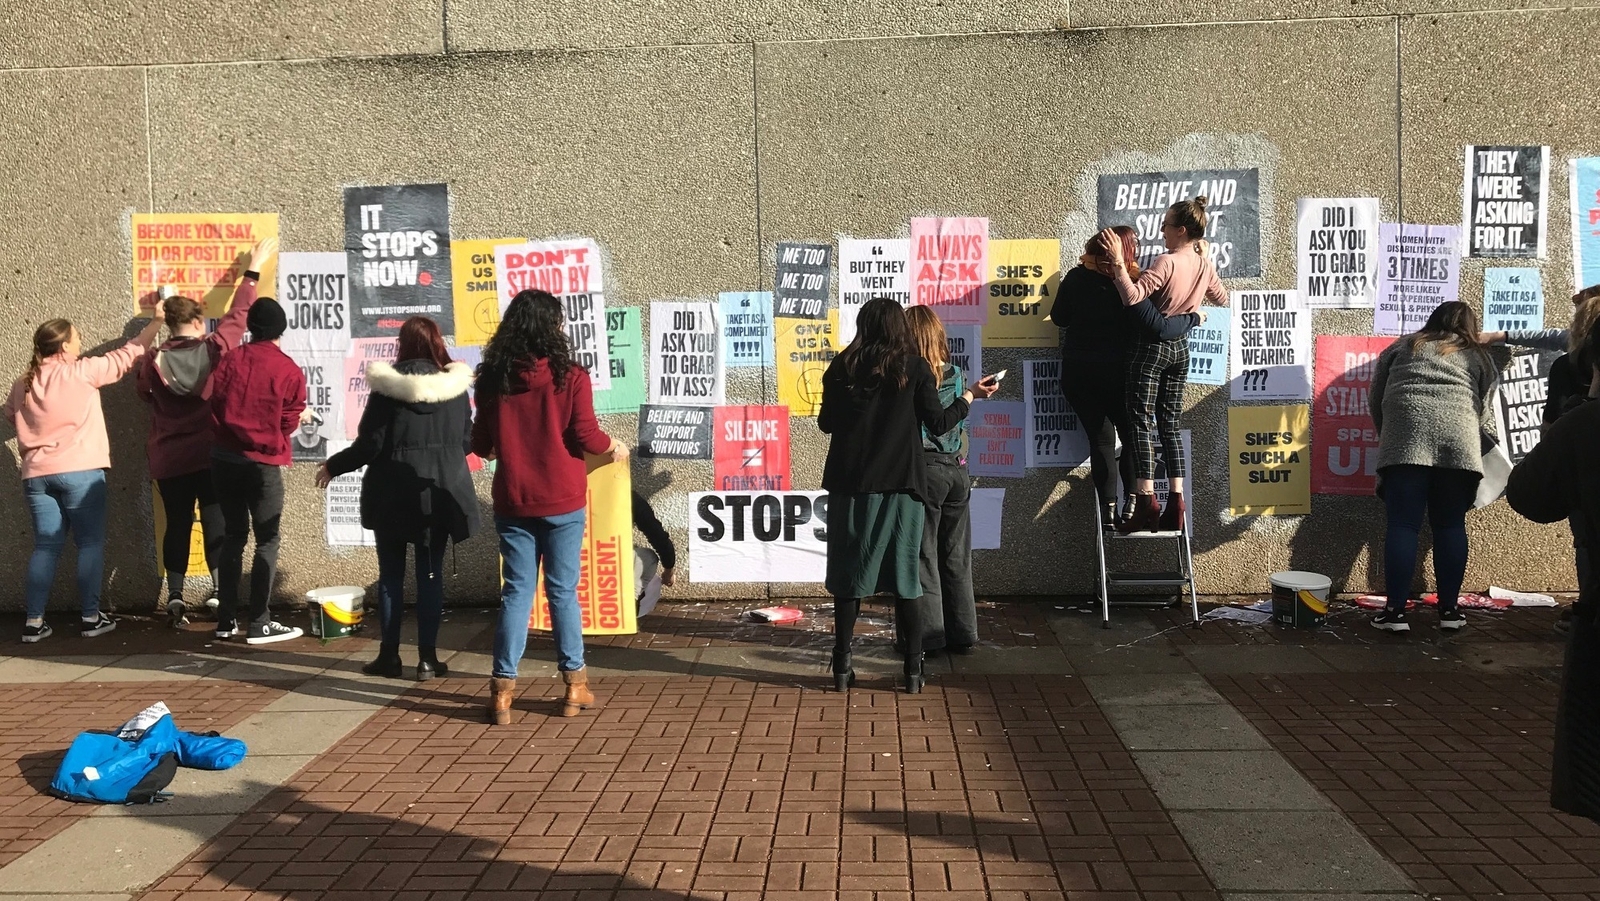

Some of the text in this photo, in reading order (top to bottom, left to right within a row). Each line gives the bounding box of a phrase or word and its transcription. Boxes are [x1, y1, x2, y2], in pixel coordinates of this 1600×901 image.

[1478, 151, 1518, 173] THEY
[1115, 181, 1192, 210] BELIEVE
[1477, 176, 1522, 199] WERE
[360, 204, 382, 230] IT
[1322, 207, 1353, 227] DID I
[1475, 201, 1534, 224] ASKING
[137, 224, 256, 241] BEFORE YOU SAY,
[1309, 230, 1366, 250] ASK YOU
[1395, 235, 1423, 244] WOMEN
[1474, 226, 1526, 249] FOR IT.
[362, 231, 438, 258] STOPS
[917, 235, 982, 261] ALWAYS
[1387, 245, 1436, 254] DISABILITIES
[138, 246, 159, 261] DO
[162, 246, 180, 261] OR
[184, 246, 220, 261] POST
[471, 254, 495, 264] GIV
[505, 248, 588, 269] DON'T
[782, 248, 825, 265] ME TOO
[850, 261, 905, 273] BUT THEY
[996, 265, 1043, 278] SHE'S
[1310, 253, 1366, 273] TO GRAB
[1388, 256, 1449, 280] 3 TIMES
[138, 268, 240, 283] CHECK IF THEY
[363, 260, 433, 287] NOW.
[472, 268, 492, 278] US
[917, 263, 979, 281] ASK
[287, 274, 345, 301] SEXIST
[507, 266, 590, 298] STAND BY
[781, 273, 823, 290] ME TOO
[861, 277, 894, 288] WENT
[1309, 276, 1367, 296] MY ASS?
[917, 284, 982, 306] CONSENT
[990, 284, 1049, 297] SUCH A
[1492, 291, 1536, 301] TAKE IT AS A
[566, 294, 594, 321] UP!
[779, 298, 822, 315] ME TOO
[998, 303, 1040, 316] SLUT
[1241, 294, 1286, 311] DID YOU
[1488, 304, 1538, 315] COMPLIMENT
[289, 303, 344, 330] JOKES
[674, 311, 702, 330] DID I
[726, 314, 766, 324] TAKE IT AS A
[1241, 312, 1297, 329] SEE WHAT
[1397, 314, 1429, 322] VIOLENC
[724, 326, 769, 337] COMPLIMENT
[795, 324, 831, 335] GIVE
[1199, 329, 1205, 339] IT
[1206, 330, 1216, 340] AS
[661, 333, 714, 352] ASK YOU
[796, 337, 831, 348] US A
[1241, 330, 1291, 347] SHE WAS
[661, 355, 714, 374] TO GRAB
[1241, 348, 1294, 365] WEARING
[1033, 362, 1058, 378] HOW
[660, 377, 716, 396] MY ASS?
[1033, 380, 1061, 396] MUC
[1242, 369, 1268, 391] ???
[317, 387, 331, 405] BE
[1503, 378, 1548, 405] WERE
[1033, 398, 1057, 413] YOU
[1326, 387, 1371, 416] STAN
[647, 410, 704, 424] BELIEVE AND
[984, 414, 1011, 425] SEXUAL
[1034, 415, 1077, 431] THOUGH
[654, 425, 697, 439] SUPPORT
[724, 420, 778, 442] SILENCE
[972, 427, 1022, 439] HARASSMENT
[1245, 432, 1292, 446] SHE'S
[650, 440, 700, 455] SURVIVORS
[987, 441, 1006, 451] ISN'T
[1035, 434, 1060, 455] ???
[980, 454, 1014, 465] FLATTERY
[1240, 451, 1299, 465] SUCH A
[722, 475, 783, 491] CONSENT
[1249, 470, 1291, 483] SLUT
[596, 536, 619, 629] CONSENT.
